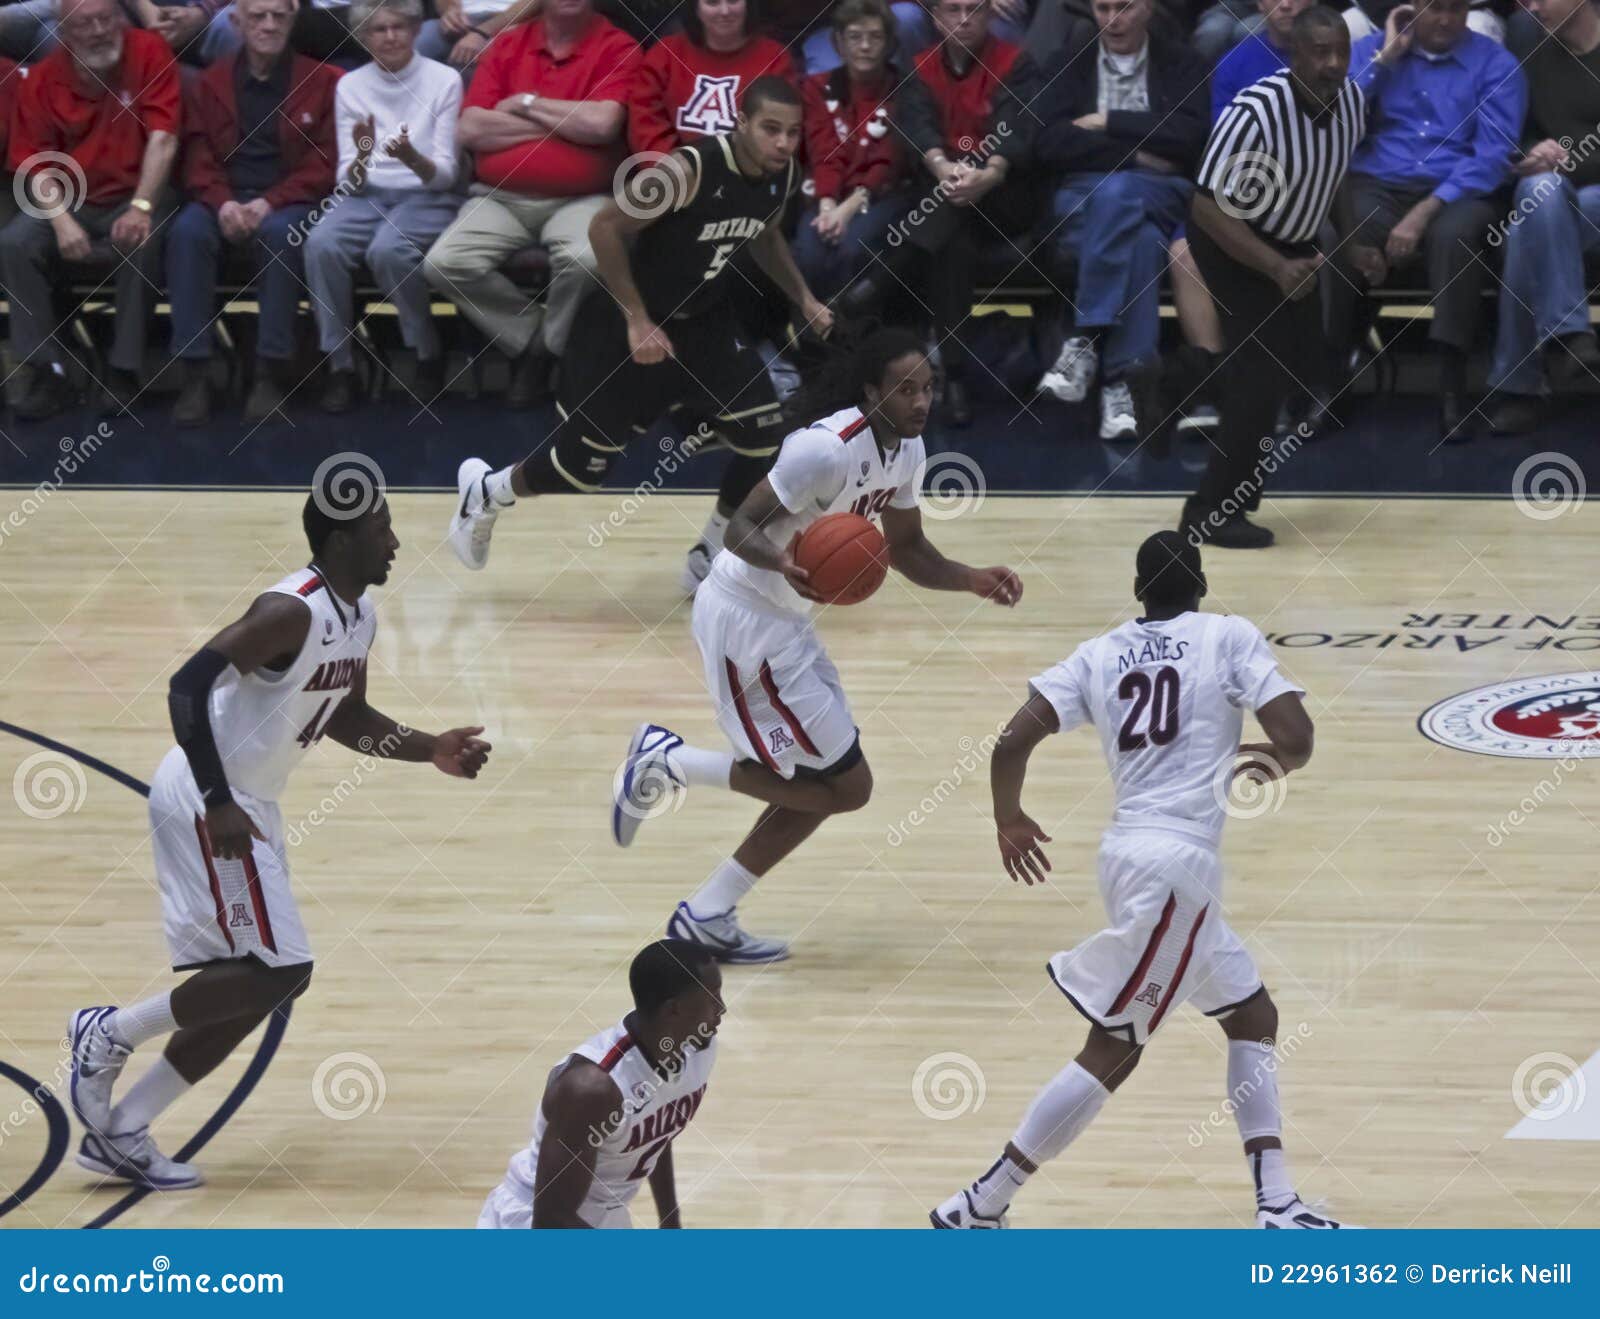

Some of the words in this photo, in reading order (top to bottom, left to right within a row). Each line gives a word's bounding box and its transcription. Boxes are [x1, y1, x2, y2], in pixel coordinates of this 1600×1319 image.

[676, 74, 740, 136] A
[703, 243, 734, 280] 5
[1118, 636, 1189, 674] MAYES
[1267, 632, 1508, 653] ARIZO
[1117, 665, 1180, 752] 20
[768, 727, 794, 754] A
[230, 903, 253, 927] A
[1134, 982, 1162, 1008] A
